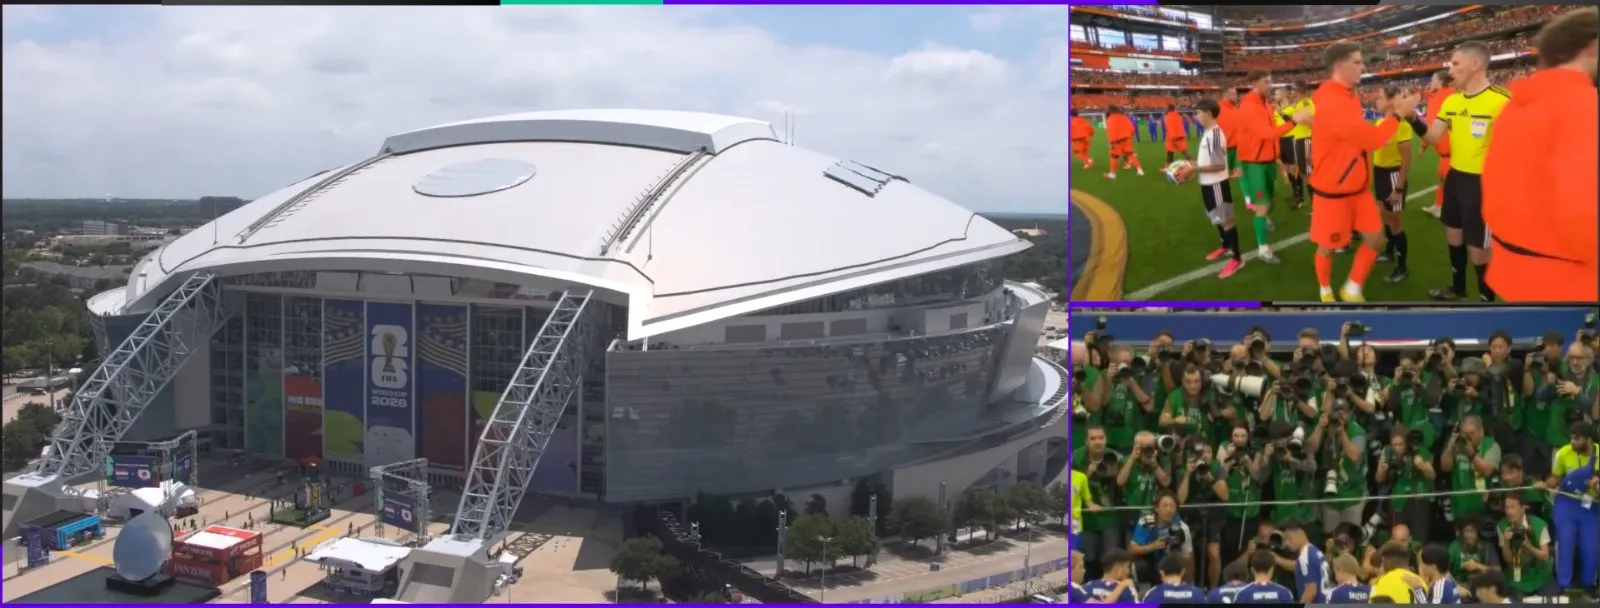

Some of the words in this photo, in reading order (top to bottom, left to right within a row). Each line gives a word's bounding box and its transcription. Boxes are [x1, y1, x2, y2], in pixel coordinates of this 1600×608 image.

[371, 389, 394, 397] WORLD
[371, 396, 408, 408] 2026
[174, 563, 189, 574] FAN
[190, 565, 211, 578] ZONE
